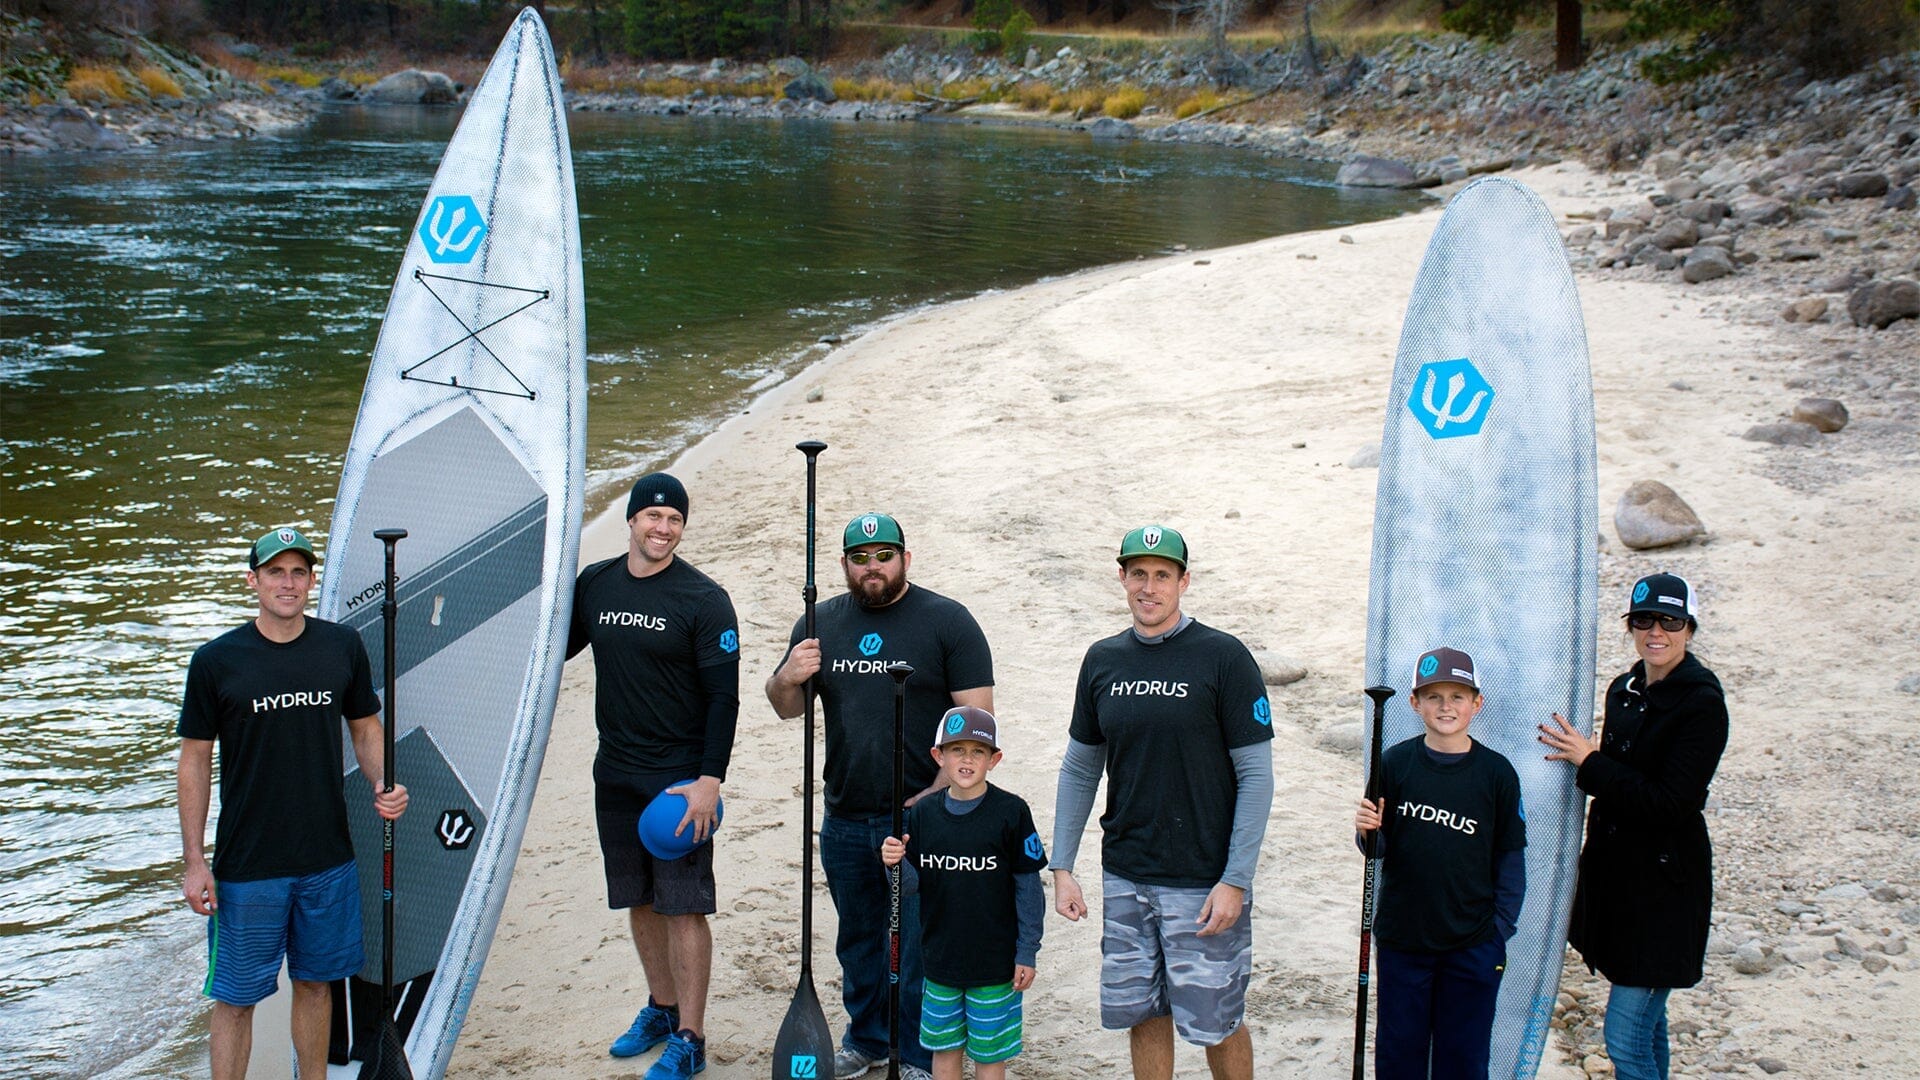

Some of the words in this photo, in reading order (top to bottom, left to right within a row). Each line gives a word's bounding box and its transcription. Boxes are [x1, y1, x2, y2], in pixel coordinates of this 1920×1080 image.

[598, 611, 667, 631] HYDRUS
[832, 659, 907, 674] HYDRU
[1110, 680, 1189, 698] HYDRUS
[252, 690, 332, 713] HYDRUS
[1397, 801, 1478, 835] HYDRUS
[920, 854, 997, 871] HYDRUS
[890, 864, 900, 932] TECHNOLOGIES
[1363, 858, 1375, 931] TECHNOLOGIES
